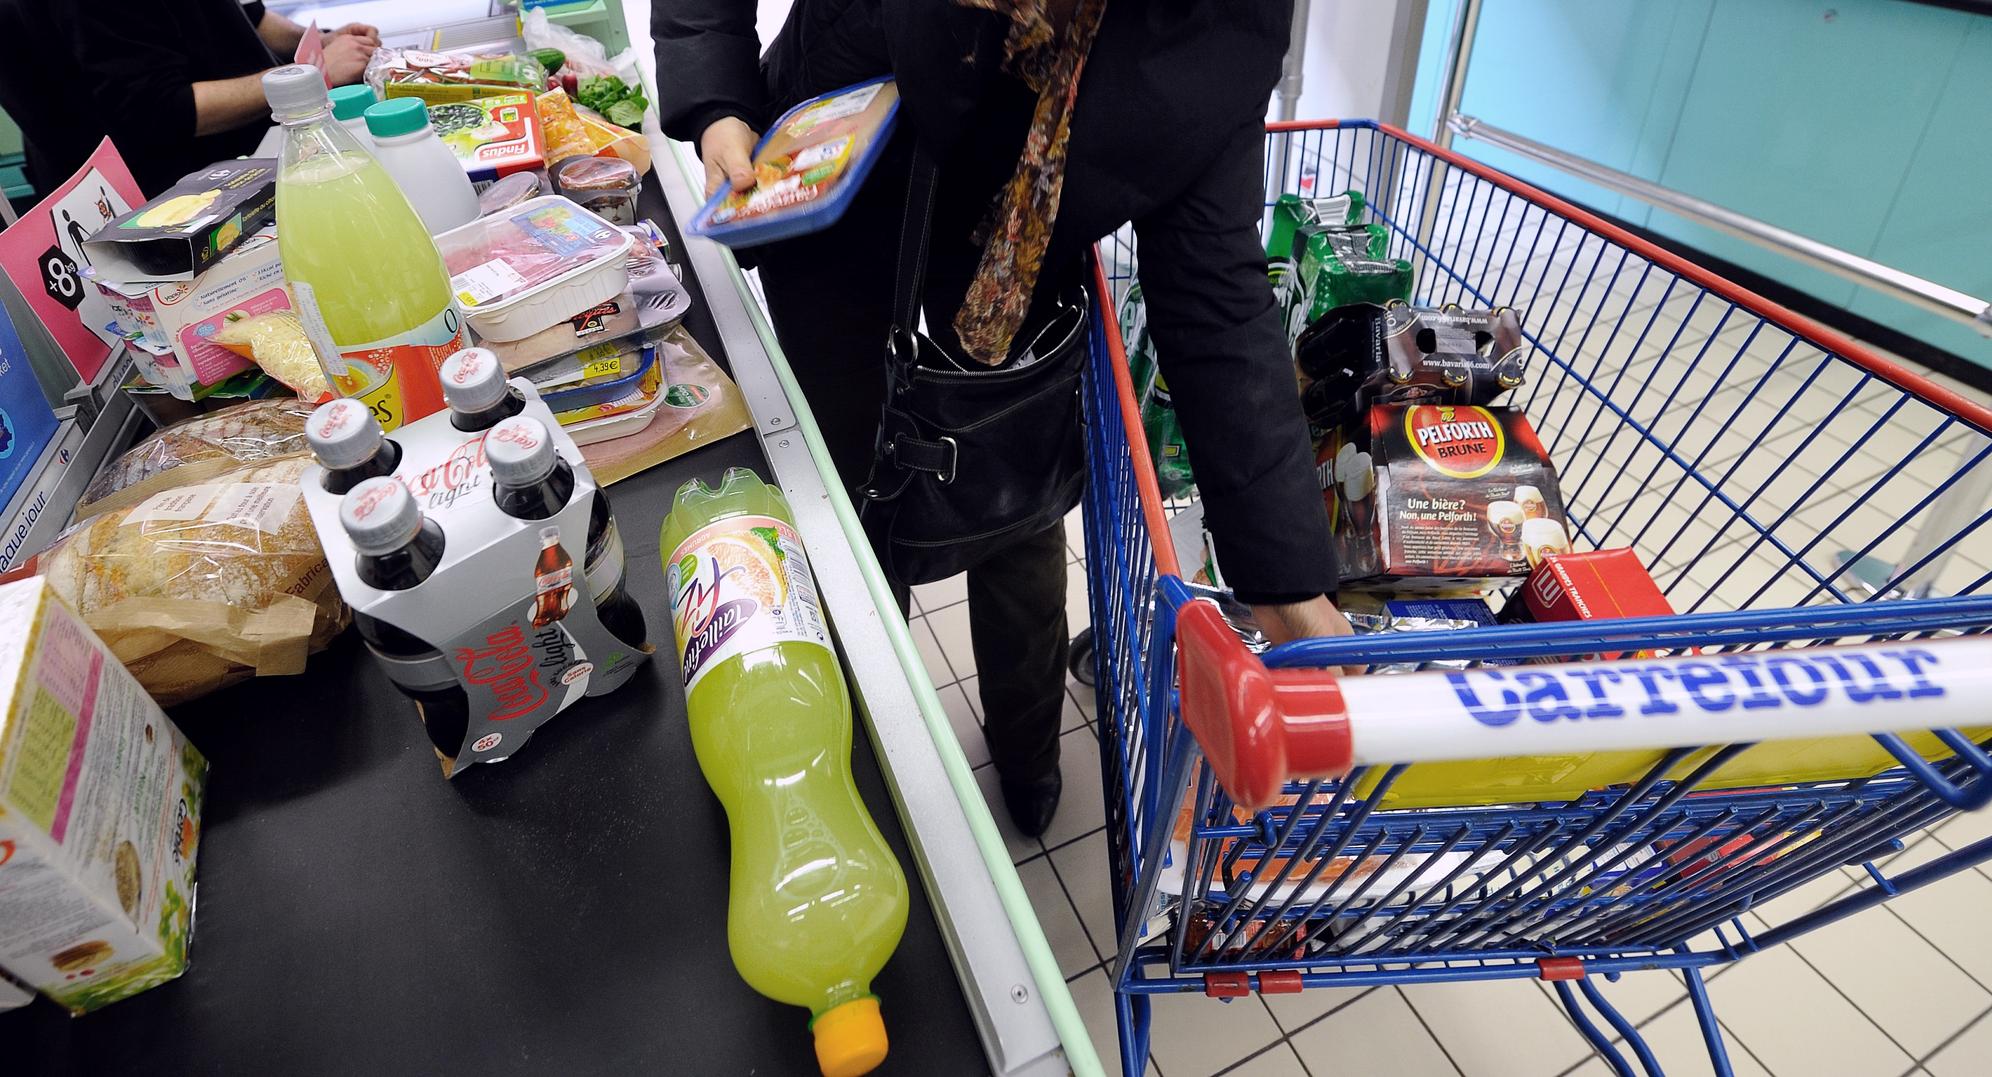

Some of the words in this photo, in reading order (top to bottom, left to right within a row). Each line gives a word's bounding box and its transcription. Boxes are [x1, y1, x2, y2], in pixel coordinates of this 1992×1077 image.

[481, 142, 527, 158] Findus
[1374, 317, 1383, 363] Bavaria
[1416, 420, 1496, 447] PELFORTH
[1437, 441, 1488, 459] BRUNE
[1399, 510, 1420, 521] Non,
[1420, 512, 1437, 521] une
[1407, 498, 1429, 509] Une
[0, 520, 29, 574] aque
[1536, 571, 1561, 601] LU
[1554, 562, 1573, 586] GRANDES
[1569, 585, 1593, 619] TRANCHES
[532, 628, 576, 668] light
[1447, 648, 1947, 728] Carrefour
